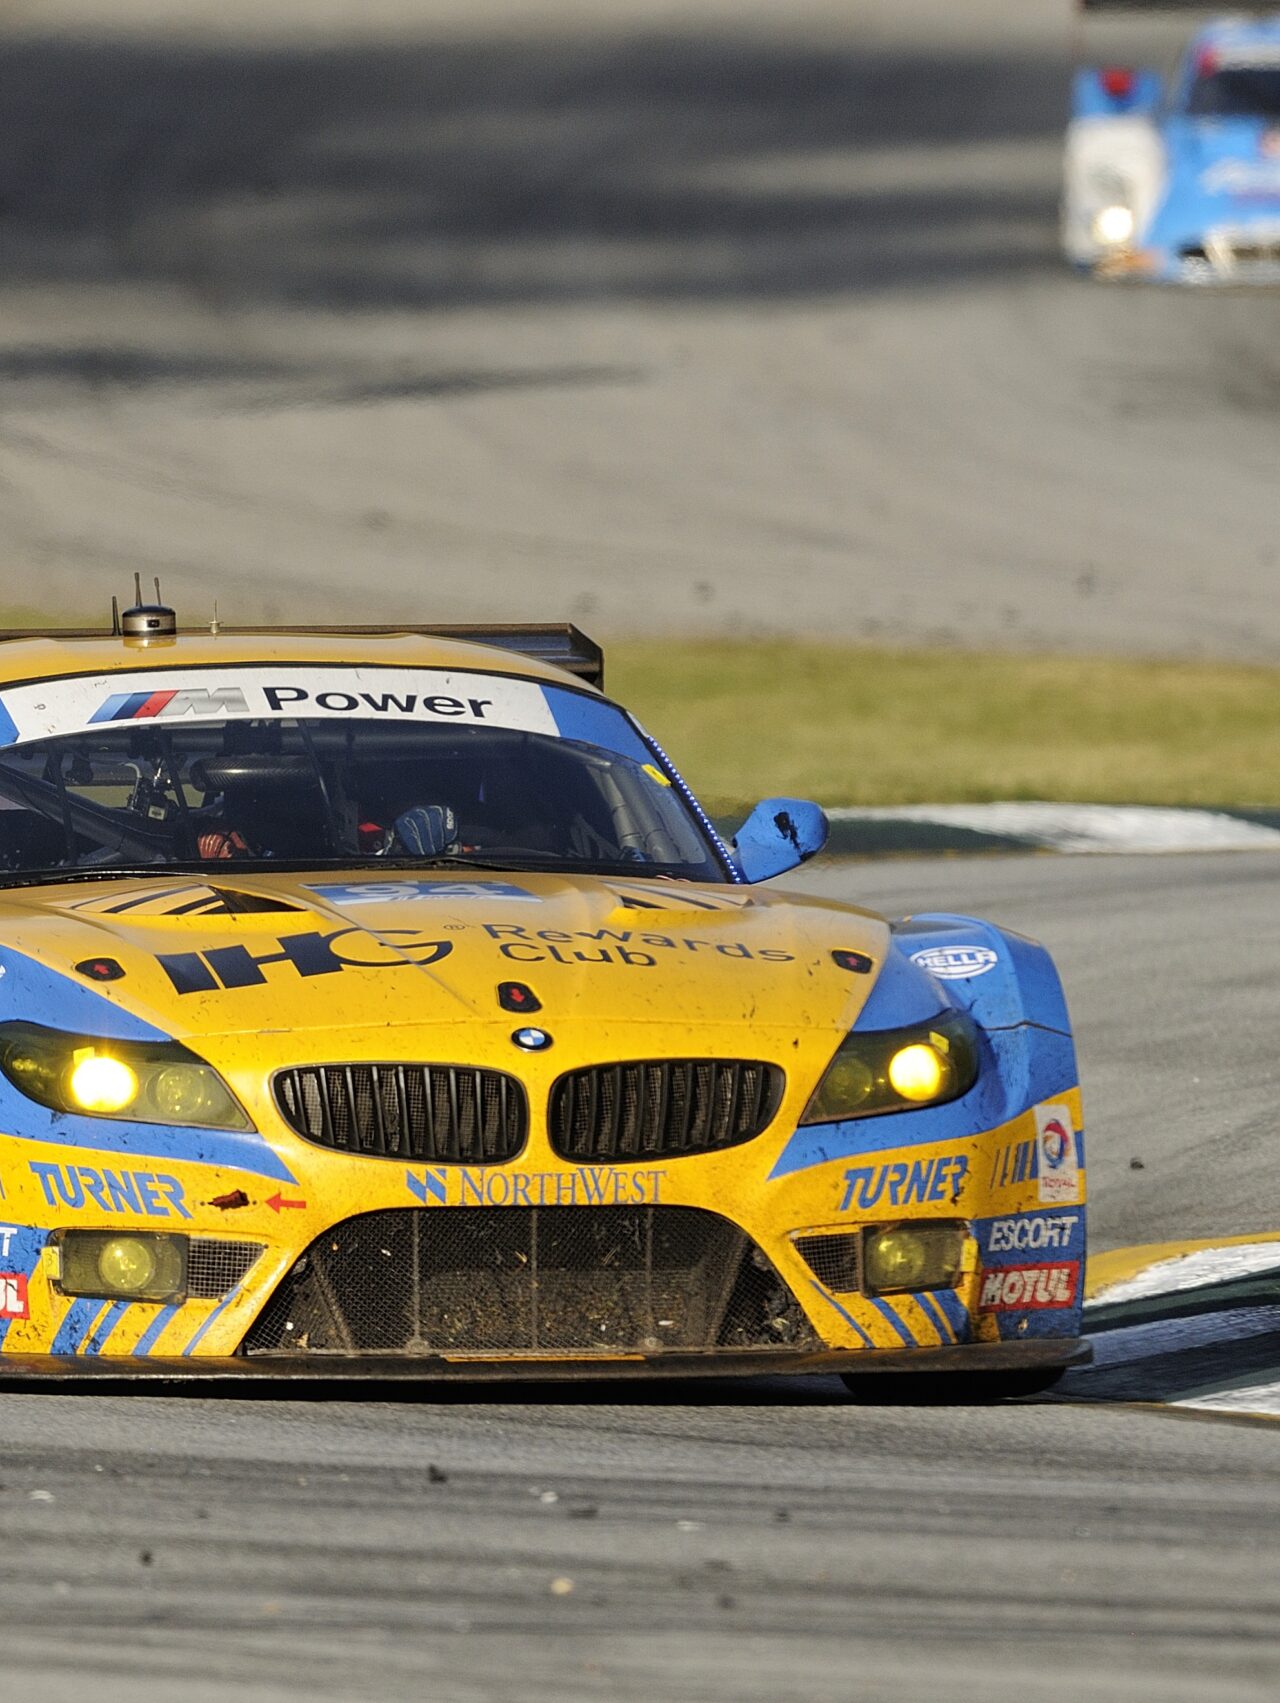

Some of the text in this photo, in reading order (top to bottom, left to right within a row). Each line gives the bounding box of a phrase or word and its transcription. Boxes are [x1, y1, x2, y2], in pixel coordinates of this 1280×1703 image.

[261, 686, 493, 718] Power
[345, 883, 505, 898] 94
[155, 922, 796, 995] IHG Rewards
[499, 942, 658, 967] Club
[915, 951, 998, 970] HELLA
[28, 1160, 194, 1220] TURNER
[839, 1154, 968, 1211] TURNER
[1041, 1175, 1078, 1189] TOTAL
[988, 1215, 1079, 1252] ESCORT
[979, 1268, 1071, 1307] MOTUL
